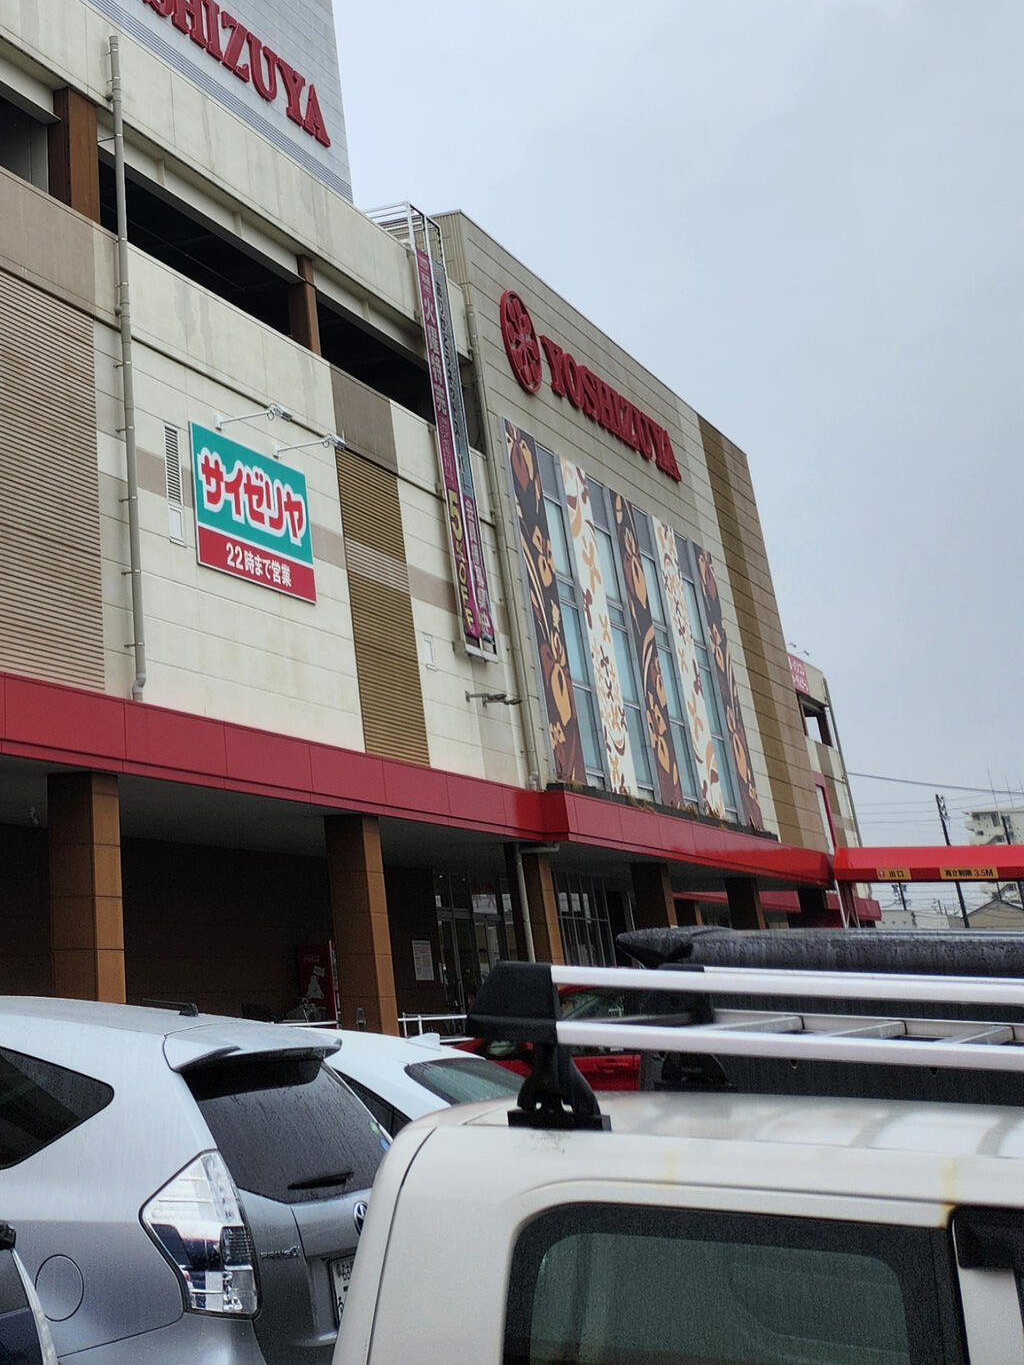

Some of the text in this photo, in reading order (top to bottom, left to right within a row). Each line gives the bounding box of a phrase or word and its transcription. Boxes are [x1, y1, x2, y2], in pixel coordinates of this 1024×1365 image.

[538, 334, 683, 483] YOSHIZUYA
[199, 451, 305, 541] サイゼリヤ
[225, 541, 293, 588] 22時まで営業
